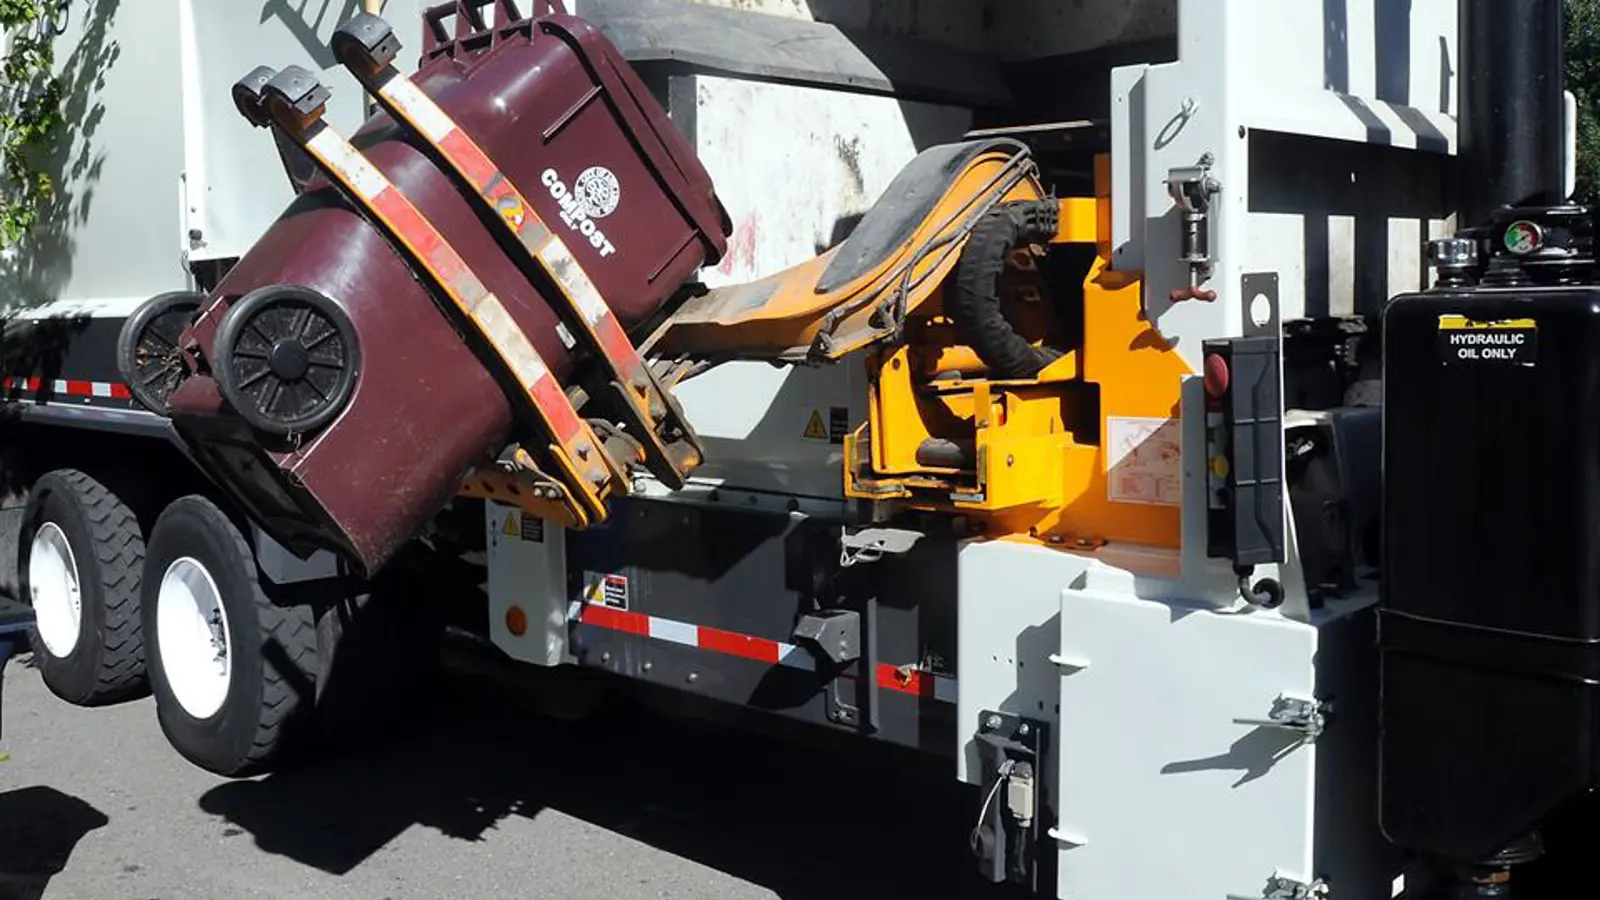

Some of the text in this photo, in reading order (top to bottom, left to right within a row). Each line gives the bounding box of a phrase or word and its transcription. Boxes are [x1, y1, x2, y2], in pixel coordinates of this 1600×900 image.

[541, 168, 616, 257] COMPOST
[1450, 333, 1525, 345] HYDRAULIC
[1457, 348, 1516, 359] OIL ONLY
